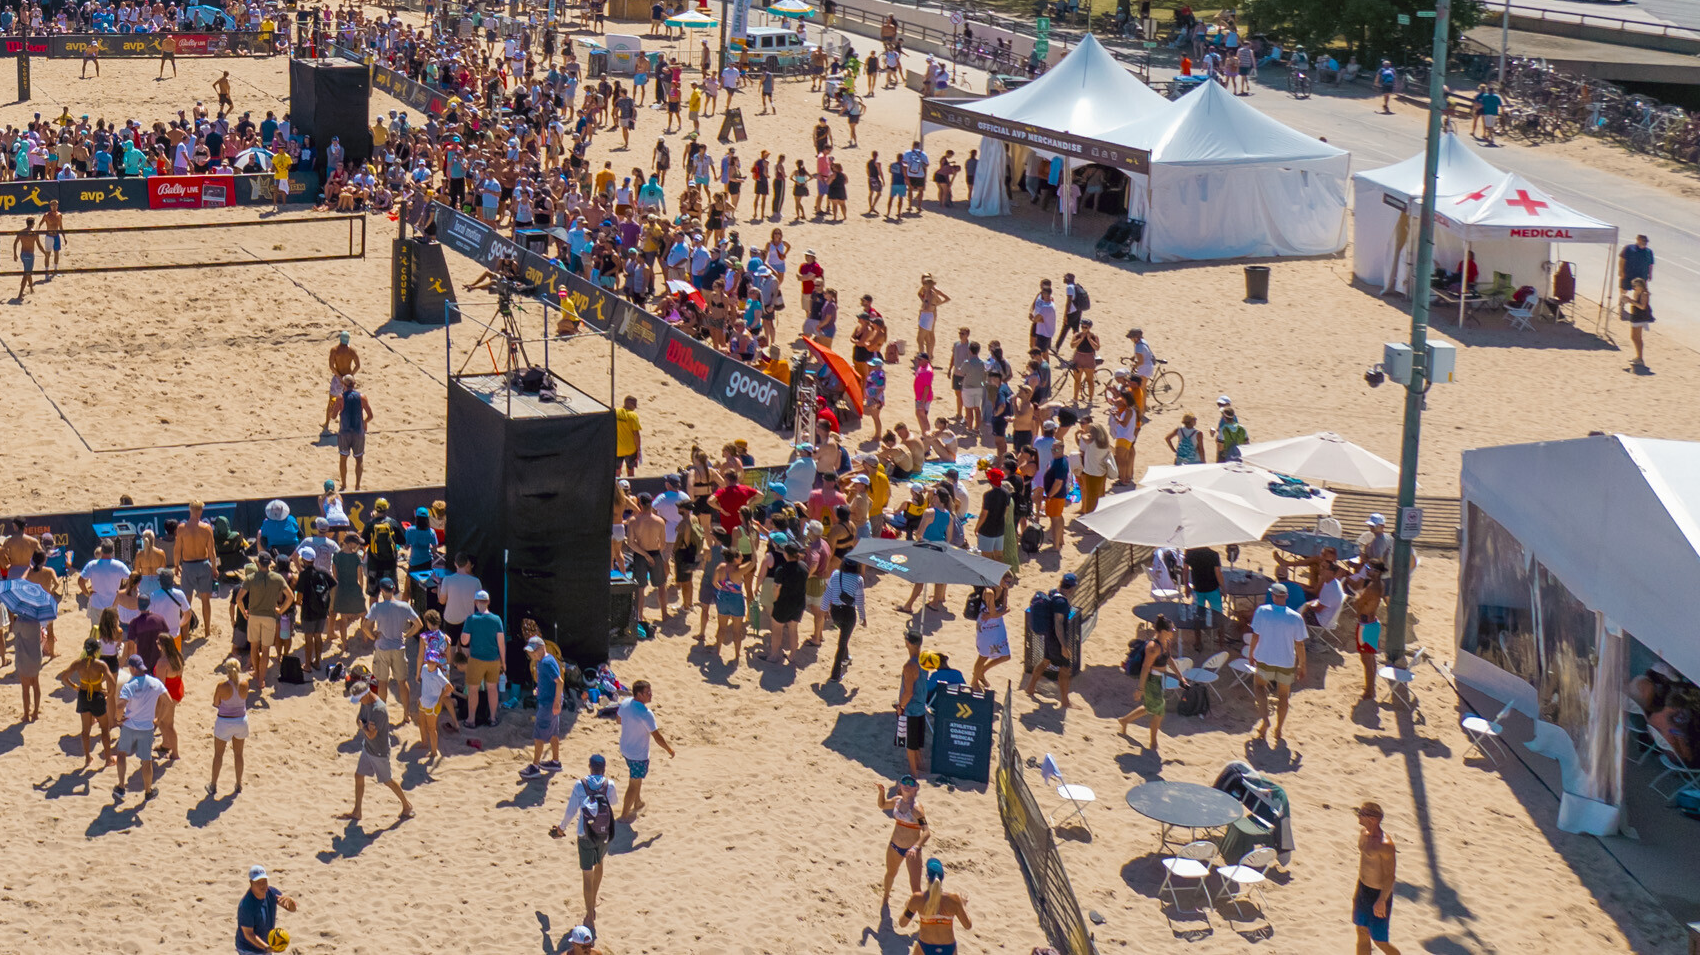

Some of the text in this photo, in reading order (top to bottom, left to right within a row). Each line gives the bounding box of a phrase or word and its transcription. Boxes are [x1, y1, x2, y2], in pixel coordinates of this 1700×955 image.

[5, 40, 48, 52] Wison
[123, 41, 145, 53] avp
[977, 121, 1083, 153] OFFICIAL AVP MERCHANDISE
[157, 183, 187, 196] Bally
[80, 190, 105, 203] avp
[453, 220, 465, 236] local
[1509, 228, 1573, 239] MEDICAL
[525, 266, 544, 286] avp
[570, 290, 589, 313] avp
[666, 337, 710, 382] Wilson
[725, 371, 779, 406] goodr
[949, 722, 977, 731] ATHLETES
[949, 728, 976, 736] COACHES
[950, 734, 975, 742] MEDICAL
